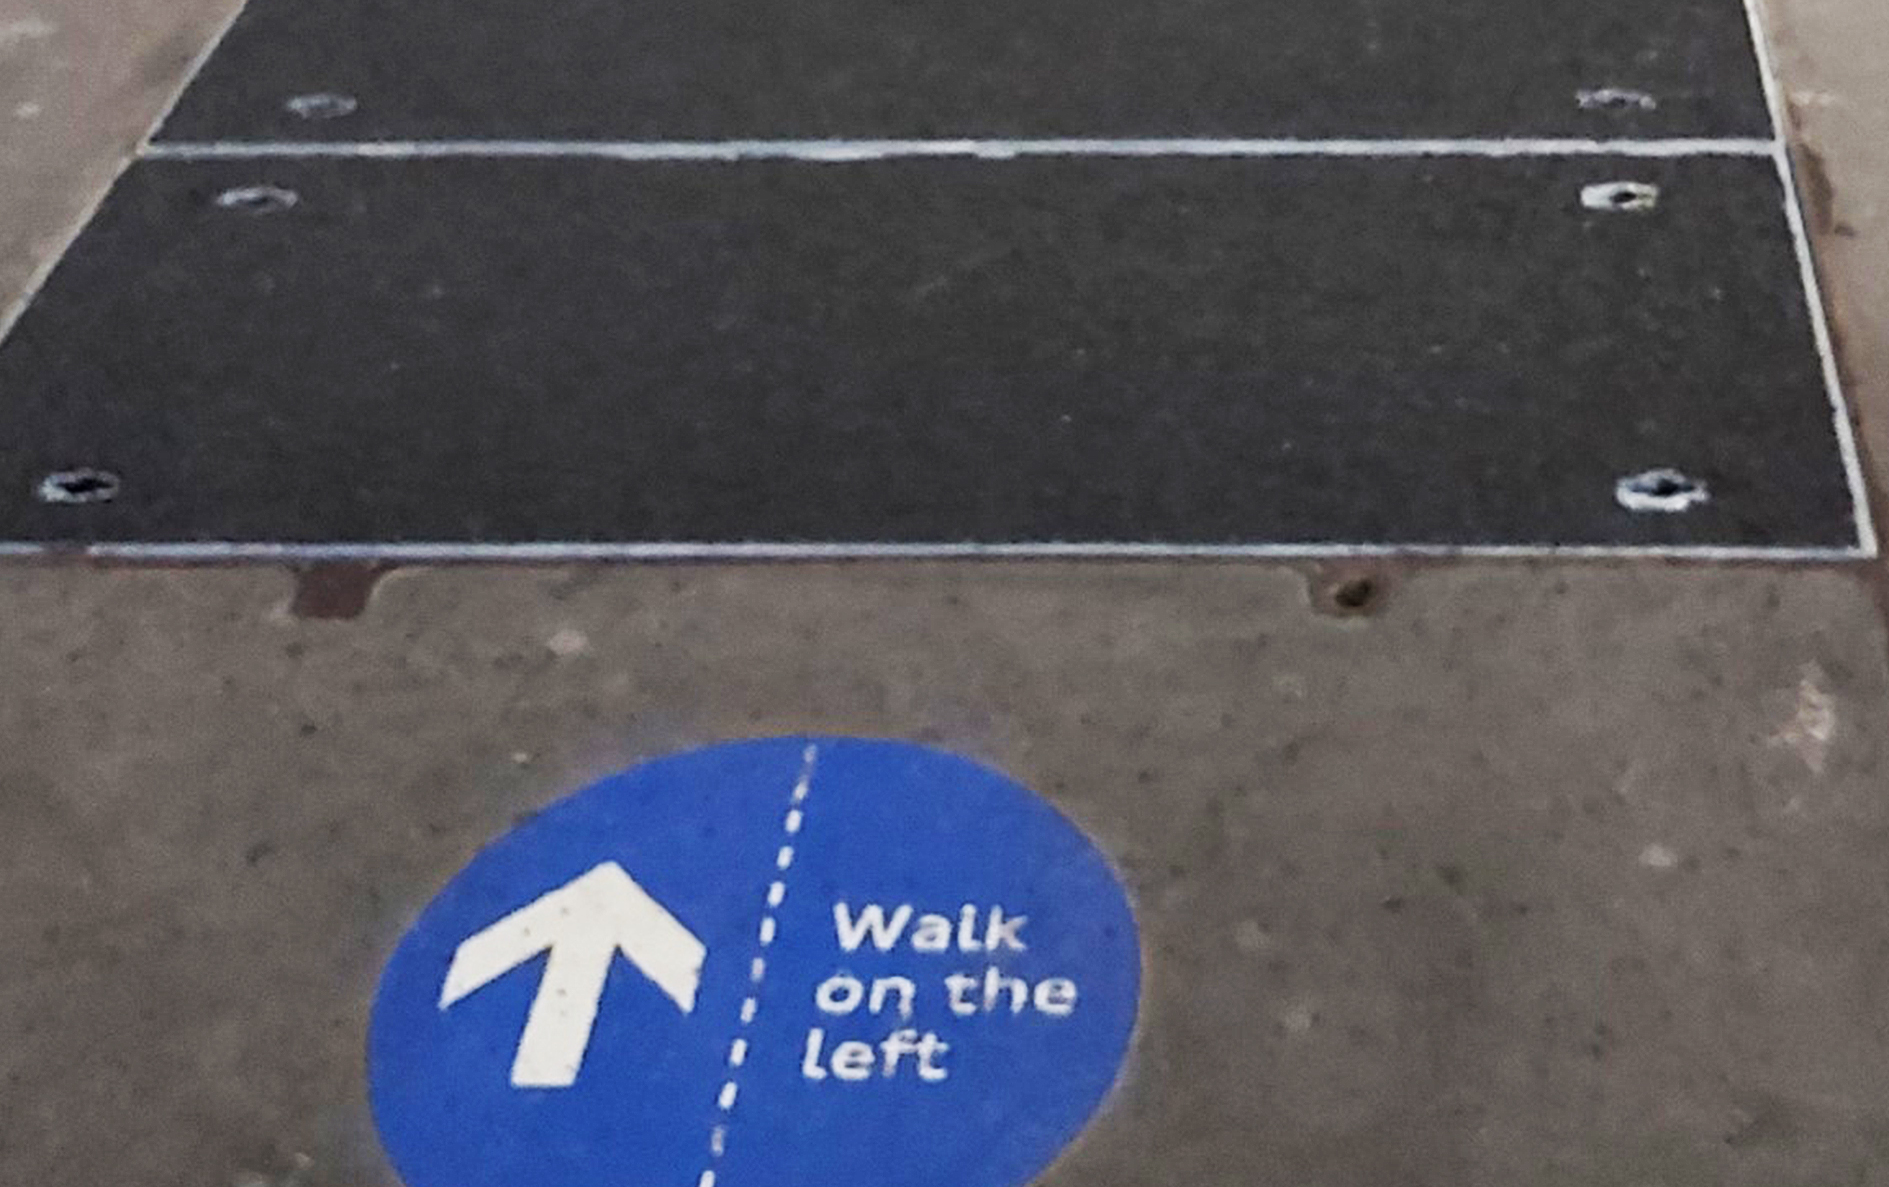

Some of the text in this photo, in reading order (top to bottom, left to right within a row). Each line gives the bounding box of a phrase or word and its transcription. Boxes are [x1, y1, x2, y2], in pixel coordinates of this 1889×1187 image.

[834, 902, 1027, 953] Walk
[815, 966, 1077, 1018] on the
[802, 1028, 948, 1081] left
